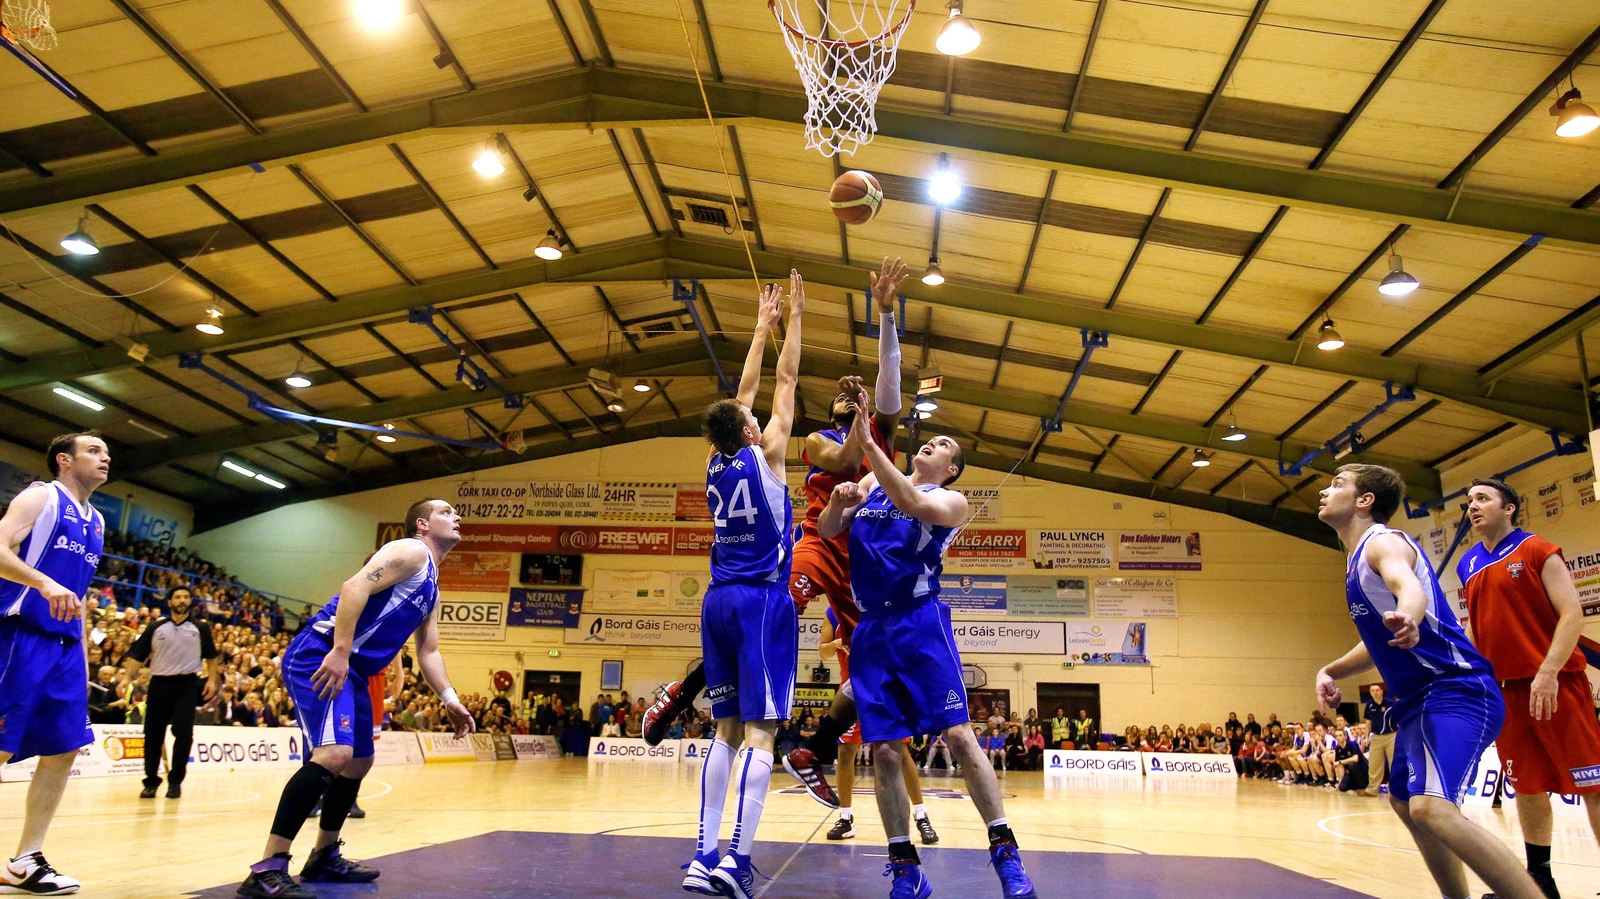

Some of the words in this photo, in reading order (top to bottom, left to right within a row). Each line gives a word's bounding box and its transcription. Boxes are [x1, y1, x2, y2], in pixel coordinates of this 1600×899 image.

[458, 486, 479, 498] CORK
[481, 487, 499, 498] TAXI
[500, 487, 526, 498] CO-OP
[529, 482, 563, 499] Northside
[565, 482, 585, 499] Glass
[586, 483, 601, 499] Ltd.
[603, 489, 636, 502] 24HR
[984, 490, 1000, 498] LTD.
[706, 478, 758, 527] 24
[460, 533, 491, 543] lackpool
[492, 533, 526, 545] Shopping
[527, 534, 552, 543] Centre
[688, 533, 714, 542] Cards
[951, 535, 1024, 547] McGARRY
[1040, 532, 1068, 541] PAUL
[1069, 532, 1105, 541] LYNCH
[1120, 533, 1135, 544] Dave
[1135, 533, 1160, 544] Kelleher
[1160, 535, 1181, 544] Motors
[545, 555, 568, 564] 7:04
[1468, 555, 1478, 573] 8
[1573, 567, 1600, 580] REPAIRS
[794, 574, 811, 596] 32
[1056, 579, 1085, 590] OCC
[1155, 579, 1163, 587] &
[526, 592, 567, 603] NEPTUNE
[525, 601, 566, 609] BASKETBALL
[440, 604, 500, 623] ROSE
[605, 619, 633, 629] Bord
[635, 619, 660, 630] Gáis
[629, 631, 662, 640] beyond
[969, 625, 995, 636] Gáis
[998, 626, 1041, 639] Energy
[963, 639, 998, 647] beyond
[709, 684, 735, 697] NIVEA
[433, 736, 470, 749] FORREST
[471, 735, 493, 751] NSG
[197, 743, 246, 763] BORD
[248, 740, 279, 762] GÁIS
[609, 746, 646, 756] BORD
[648, 745, 674, 757] GÁIS
[1066, 758, 1105, 770] BORD
[1107, 758, 1137, 771] GÁIS
[1165, 761, 1202, 773] BORD
[1203, 760, 1231, 774] GÁIS
